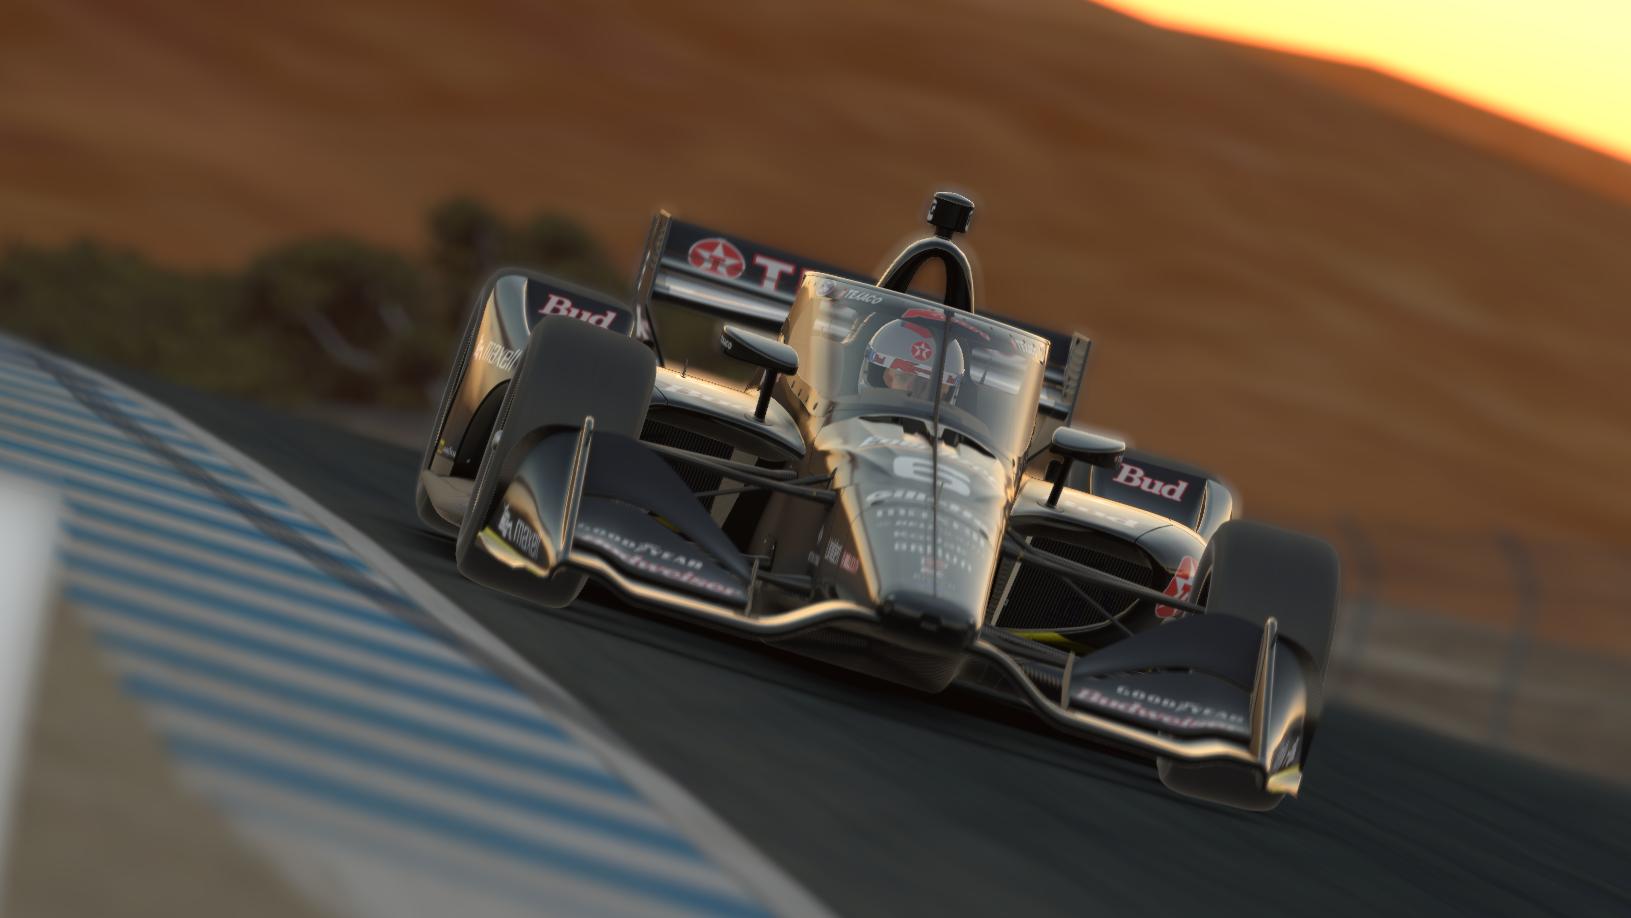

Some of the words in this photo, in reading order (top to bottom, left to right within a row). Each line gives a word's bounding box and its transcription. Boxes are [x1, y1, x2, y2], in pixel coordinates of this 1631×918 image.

[845, 289, 883, 305] TEXACO
[893, 456, 970, 497] 6
[1112, 463, 1189, 502] Bud
